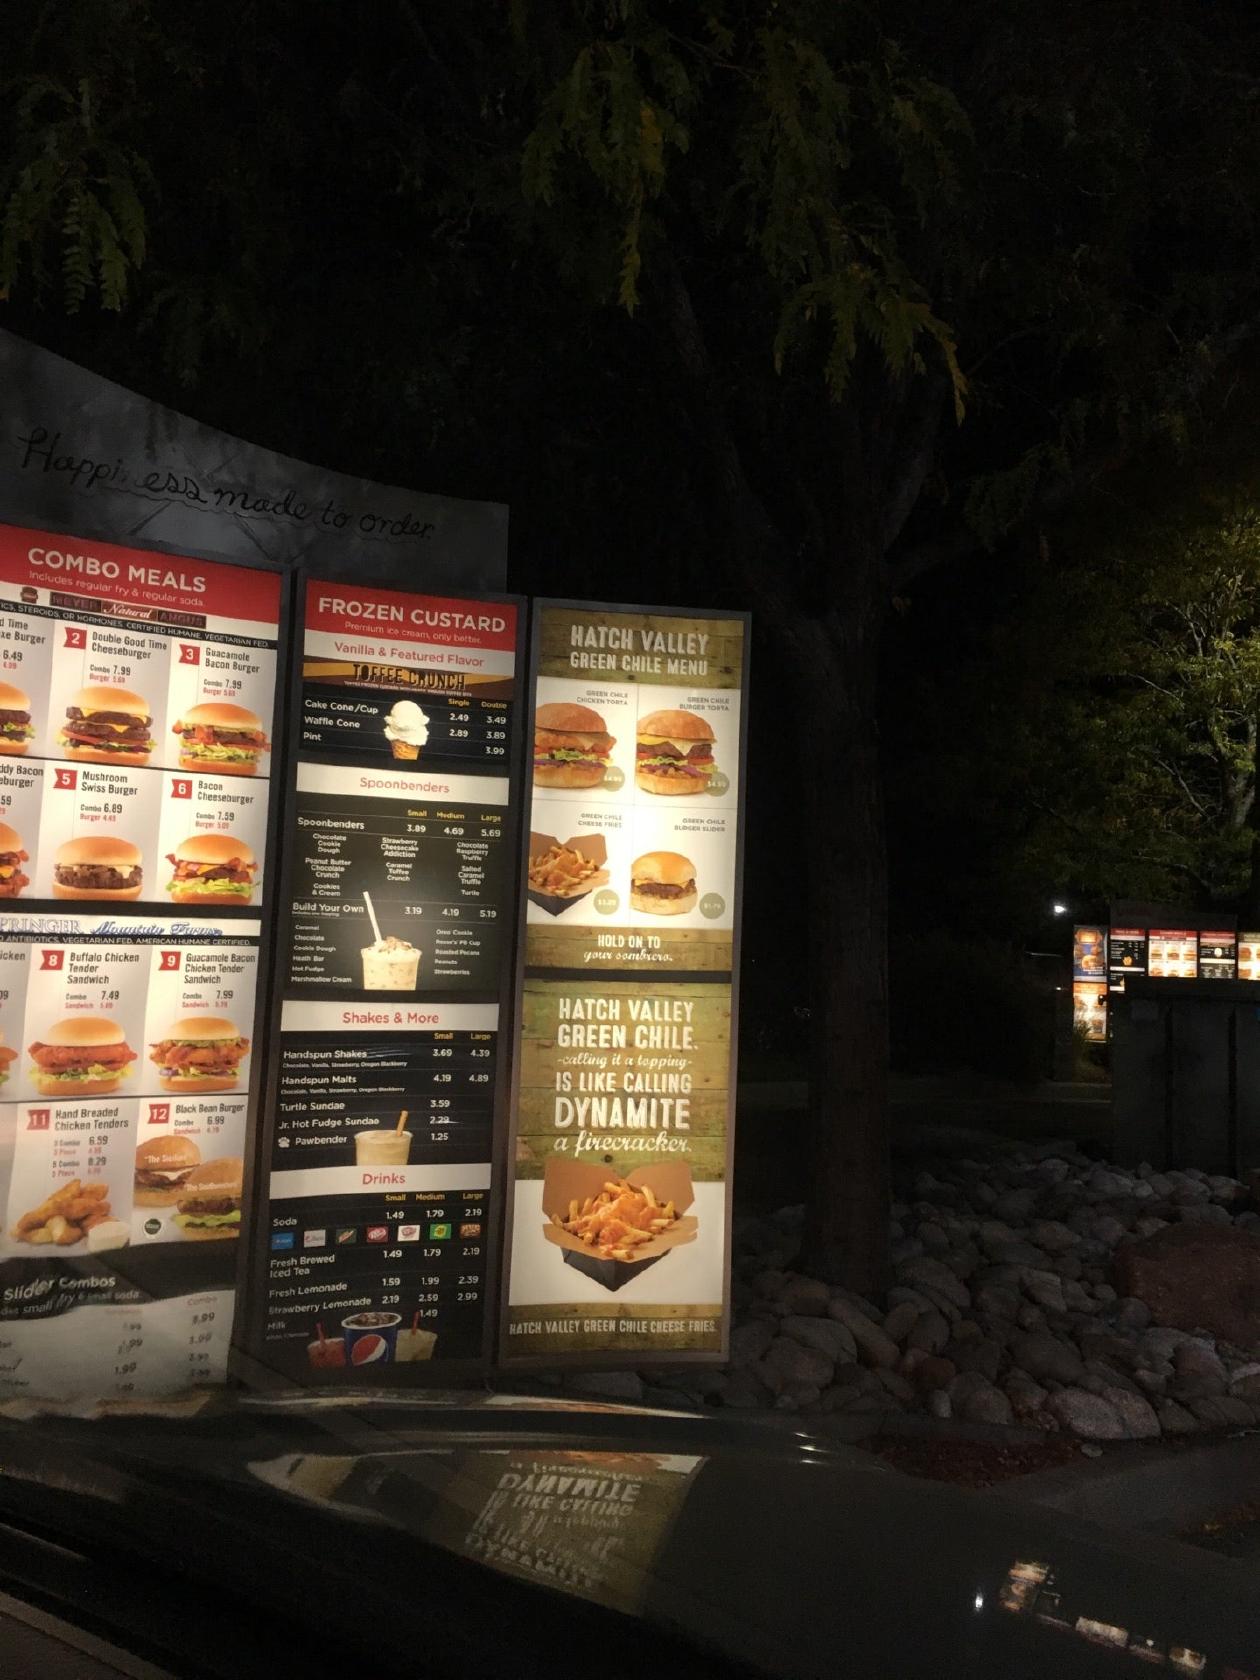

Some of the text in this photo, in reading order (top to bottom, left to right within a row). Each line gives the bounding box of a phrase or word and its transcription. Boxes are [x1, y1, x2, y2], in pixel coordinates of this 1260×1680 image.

[18, 427, 208, 504] Happiess
[214, 487, 309, 520] made
[321, 500, 353, 529] to
[28, 548, 207, 593] COMBO MEALS
[75, 577, 113, 595] regular
[115, 584, 130, 598] fry
[132, 588, 139, 597] &
[142, 591, 177, 604] regular
[318, 597, 506, 633] FROZEN CUSTARD
[14, 631, 46, 645] Burger
[71, 632, 80, 645] 2
[345, 621, 384, 635] Premium
[387, 627, 400, 635] ice
[433, 632, 452, 644] only
[92, 631, 167, 651] Double Good Time
[571, 624, 709, 656] HATCH VALLEY
[91, 642, 152, 661] Cheeseburger
[185, 648, 195, 660] 3
[205, 647, 250, 662] Guacamole
[334, 641, 485, 667] Vanilla & Featured Flavor
[205, 658, 260, 675] Bacon Burger
[570, 651, 708, 677] GREEN CHILE MENU
[353, 664, 403, 684] TOFFEE
[408, 670, 466, 691] CRUNCH
[576, 696, 606, 705] CHICKEN
[586, 689, 629, 699] GREEN CHILE
[687, 696, 710, 704] GREEN
[447, 698, 470, 707] Single
[679, 703, 706, 711] BURGER
[304, 699, 507, 725] Cake Cone/Cup 2.49 3.49
[304, 716, 506, 740] Waffle Cone 2.89 3.89
[303, 731, 505, 755] Pint 3.99
[61, 773, 71, 785] 5
[82, 771, 128, 783] Mushroom
[81, 781, 138, 797] Swiss Burger
[178, 783, 187, 795] 6
[198, 780, 223, 791] Bacon
[359, 777, 451, 793] Spoonbenders
[197, 791, 254, 806] Cheeseburger
[312, 833, 347, 841] Chocolate
[456, 842, 489, 850] Chocolate
[383, 850, 416, 858] Addiction
[597, 934, 661, 948] HOLD ON TO
[48, 954, 58, 967] 8
[70, 952, 140, 962] Buffalo Chicken
[168, 955, 176, 967] 9
[186, 952, 256, 963] Guacamole Bacon
[583, 950, 613, 963] your
[185, 963, 244, 973] Chicken Tender
[67, 974, 110, 985] Sandwich
[184, 974, 222, 984] Sandwich
[342, 1011, 440, 1024] Shakes & More
[559, 998, 694, 1024] HATCH VALLEY
[557, 1024, 627, 1048] GREEN
[283, 1048, 490, 1060] Handspun Shakes 3.69 4.39
[611, 1055, 622, 1067] it
[625, 1057, 634, 1066] a
[281, 1074, 489, 1086] Handspun Malts 4.19 4.89
[556, 1071, 693, 1095] IS LIKE CALLING
[175, 1102, 245, 1114] Black Bean Burger
[280, 1099, 450, 1112] Turtle Sundae 3.59
[32, 1113, 47, 1126] 11
[55, 1107, 119, 1119] Hand Breaded
[151, 1108, 168, 1120] 12
[554, 1096, 691, 1130] DYNAMITE
[54, 1118, 129, 1131] Chicken Tenders
[295, 1132, 449, 1146] Pawbender 1.25
[553, 1130, 693, 1158] a firecracker.
[362, 1172, 406, 1185] Drinks
[272, 1208, 483, 1227] Soda 1.49 1.79 2.19
[270, 1247, 480, 1268] Fresh Brewed 1.49 1.79 2.19
[4, 1276, 116, 1301] Slider Combos
[268, 1292, 478, 1316] Strawberry Lemonade 2.19 2.59 2.99
[509, 1321, 542, 1335] HATCH
[545, 1320, 580, 1334] VALLEY
[583, 1319, 616, 1333] GREEN
[619, 1319, 648, 1333] CHILE
[650, 1319, 687, 1333] CHEESE
